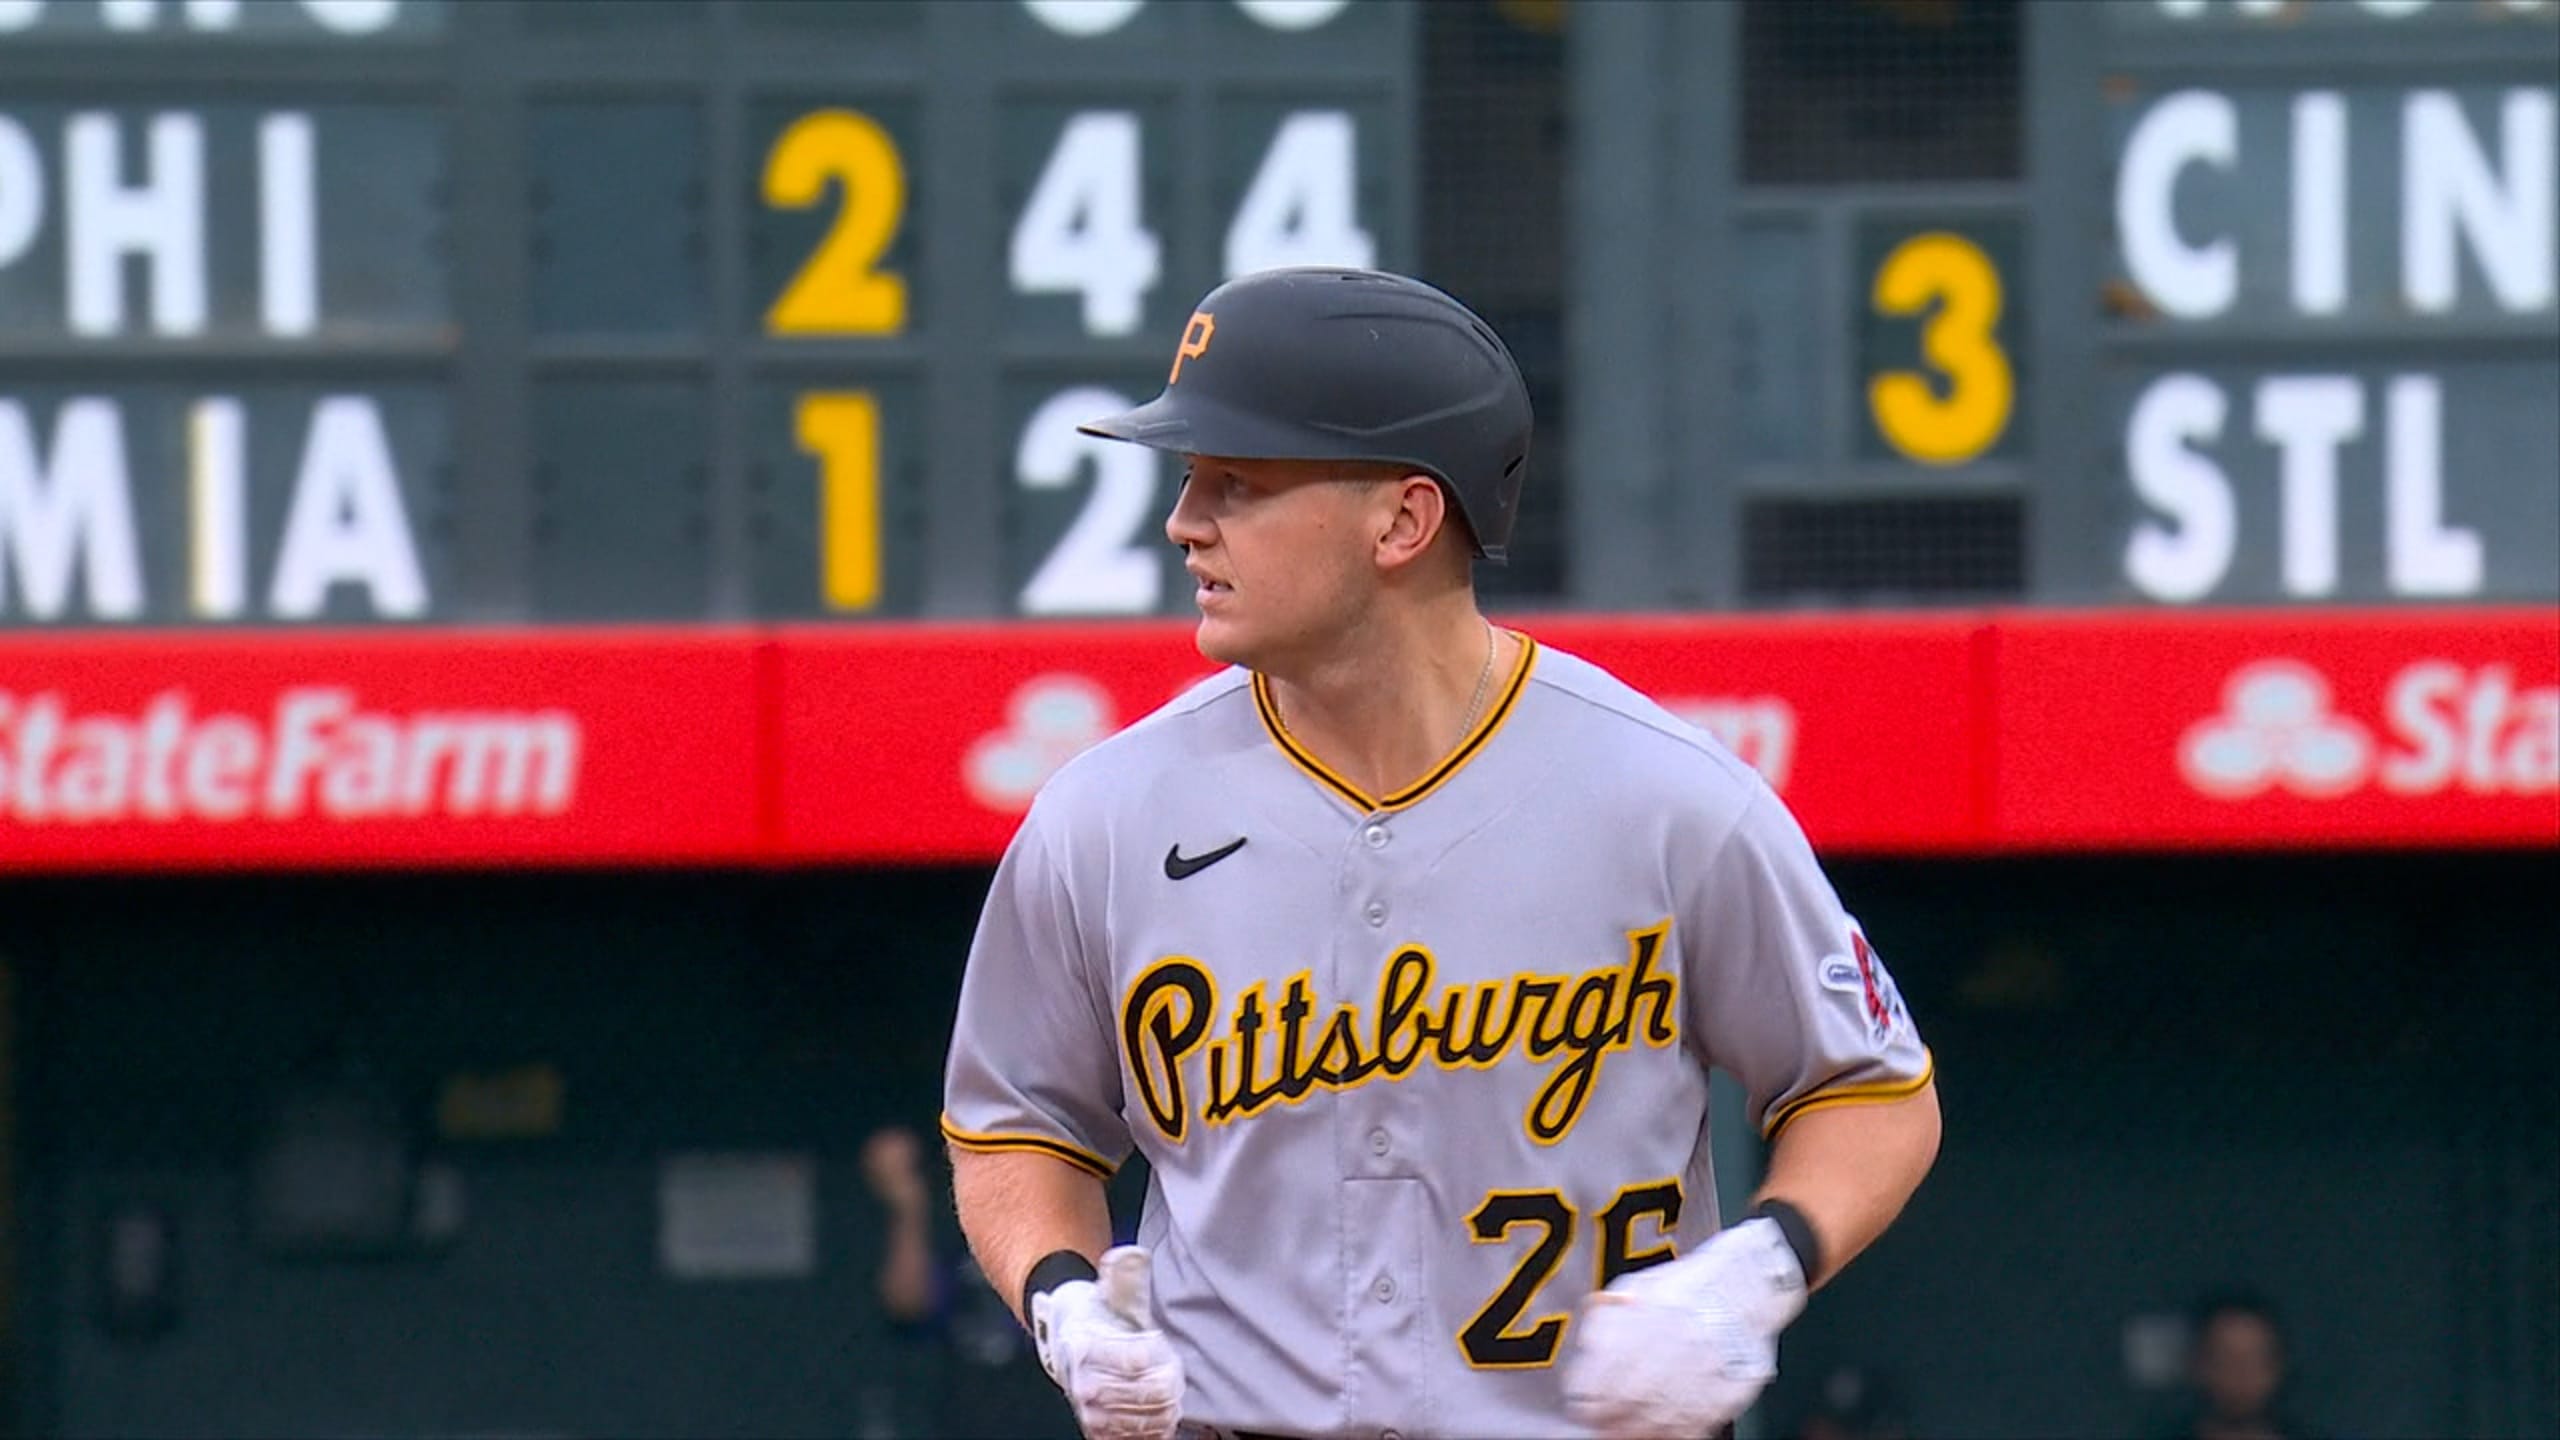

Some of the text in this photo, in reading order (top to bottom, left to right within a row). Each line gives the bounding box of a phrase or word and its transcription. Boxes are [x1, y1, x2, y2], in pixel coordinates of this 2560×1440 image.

[762, 108, 909, 336] 2
[1010, 111, 1160, 336] 4
[1226, 111, 1376, 269] 4
[2116, 88, 2557, 317] CIN
[1169, 312, 1216, 384] P
[1868, 232, 2014, 465] 3
[0, 387, 1162, 620] MIA 1 2
[2126, 373, 2483, 602] STL
[1120, 917, 1677, 1143] Pittsburgh
